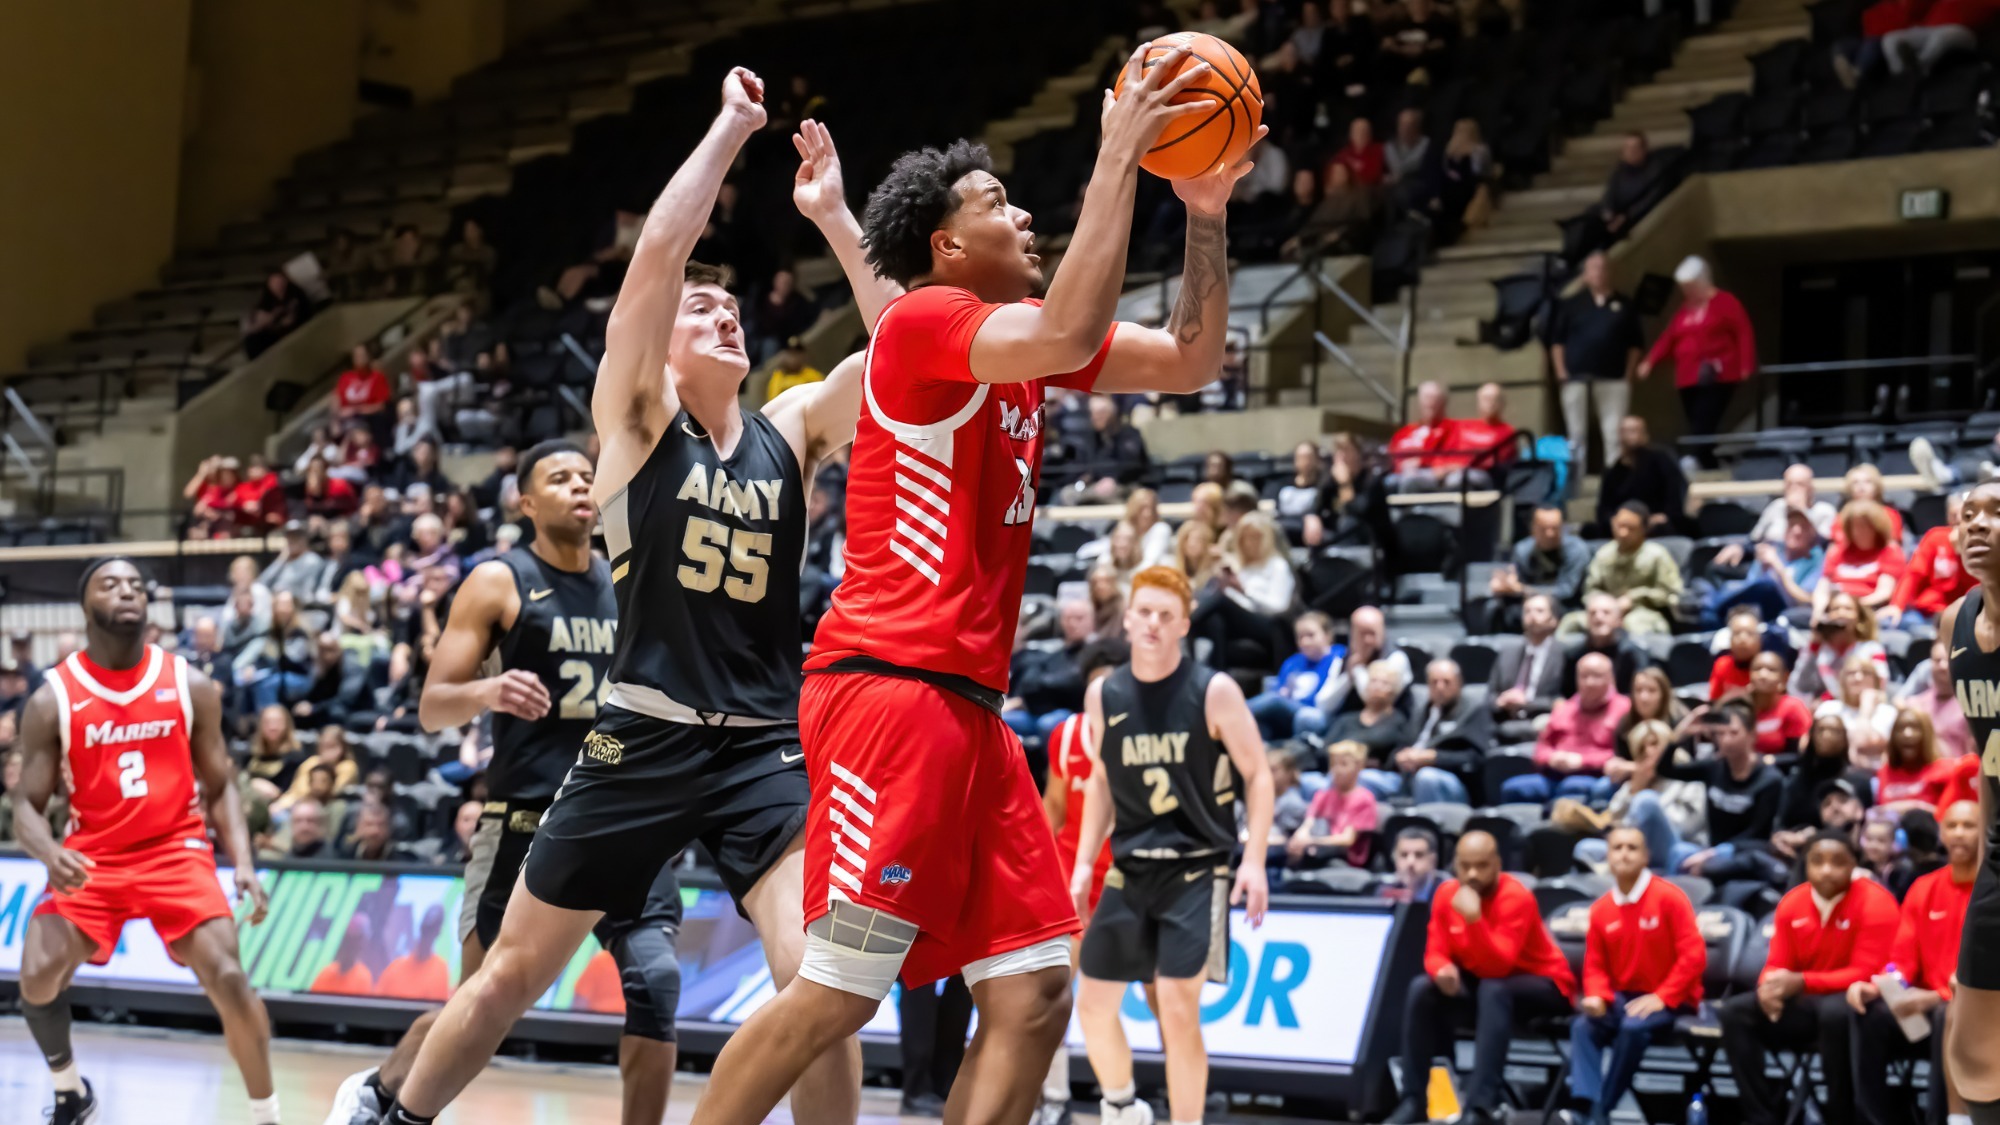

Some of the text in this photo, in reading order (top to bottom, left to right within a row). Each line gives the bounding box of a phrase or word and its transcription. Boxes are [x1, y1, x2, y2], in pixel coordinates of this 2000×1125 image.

[676, 462, 784, 521] ARMY
[676, 515, 773, 604] 55
[547, 616, 618, 654] ARM
[1956, 679, 2000, 718] ARM
[84, 719, 177, 748] MARIST
[1121, 731, 1190, 767] ARMY
[117, 750, 149, 800] 2
[1142, 766, 1179, 815] 2
[880, 865, 912, 884] MAAC
